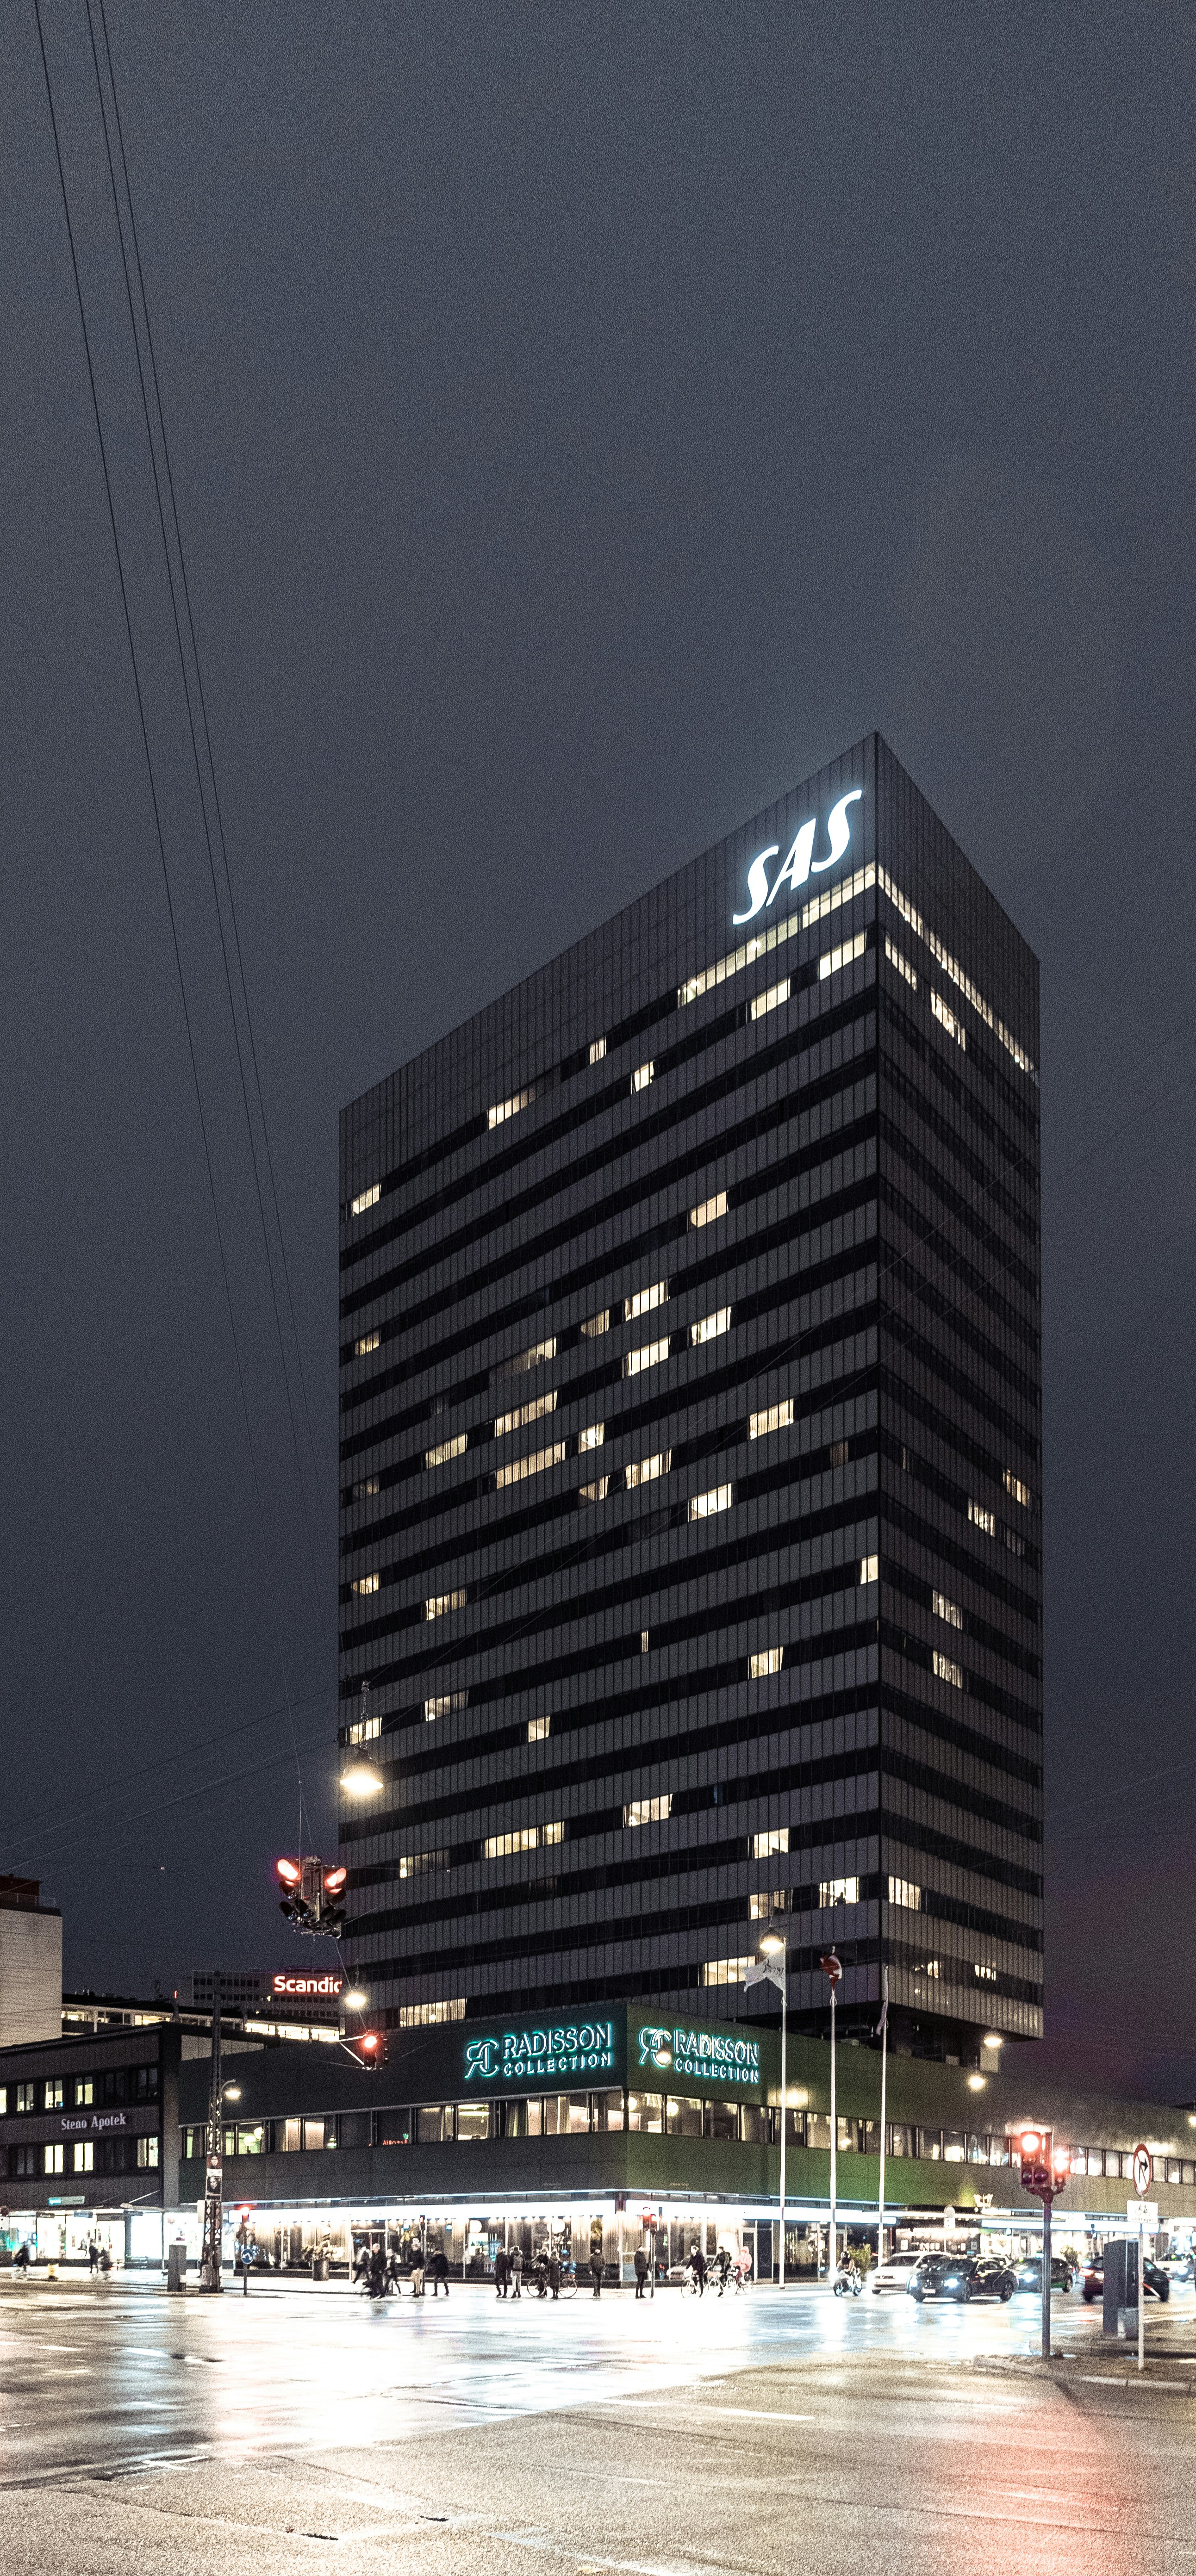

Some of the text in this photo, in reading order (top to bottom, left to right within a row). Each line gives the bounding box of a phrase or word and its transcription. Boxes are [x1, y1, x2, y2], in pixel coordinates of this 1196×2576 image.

[732, 788, 863, 925] SAS
[274, 1975, 342, 1993] Scandic
[503, 2022, 612, 2059] RADISSON
[673, 2029, 759, 2066] RADISSON
[504, 2052, 612, 2076] COLLECTION
[674, 2057, 759, 2084] COLLECTION
[61, 2113, 126, 2130] Steno Apotek
